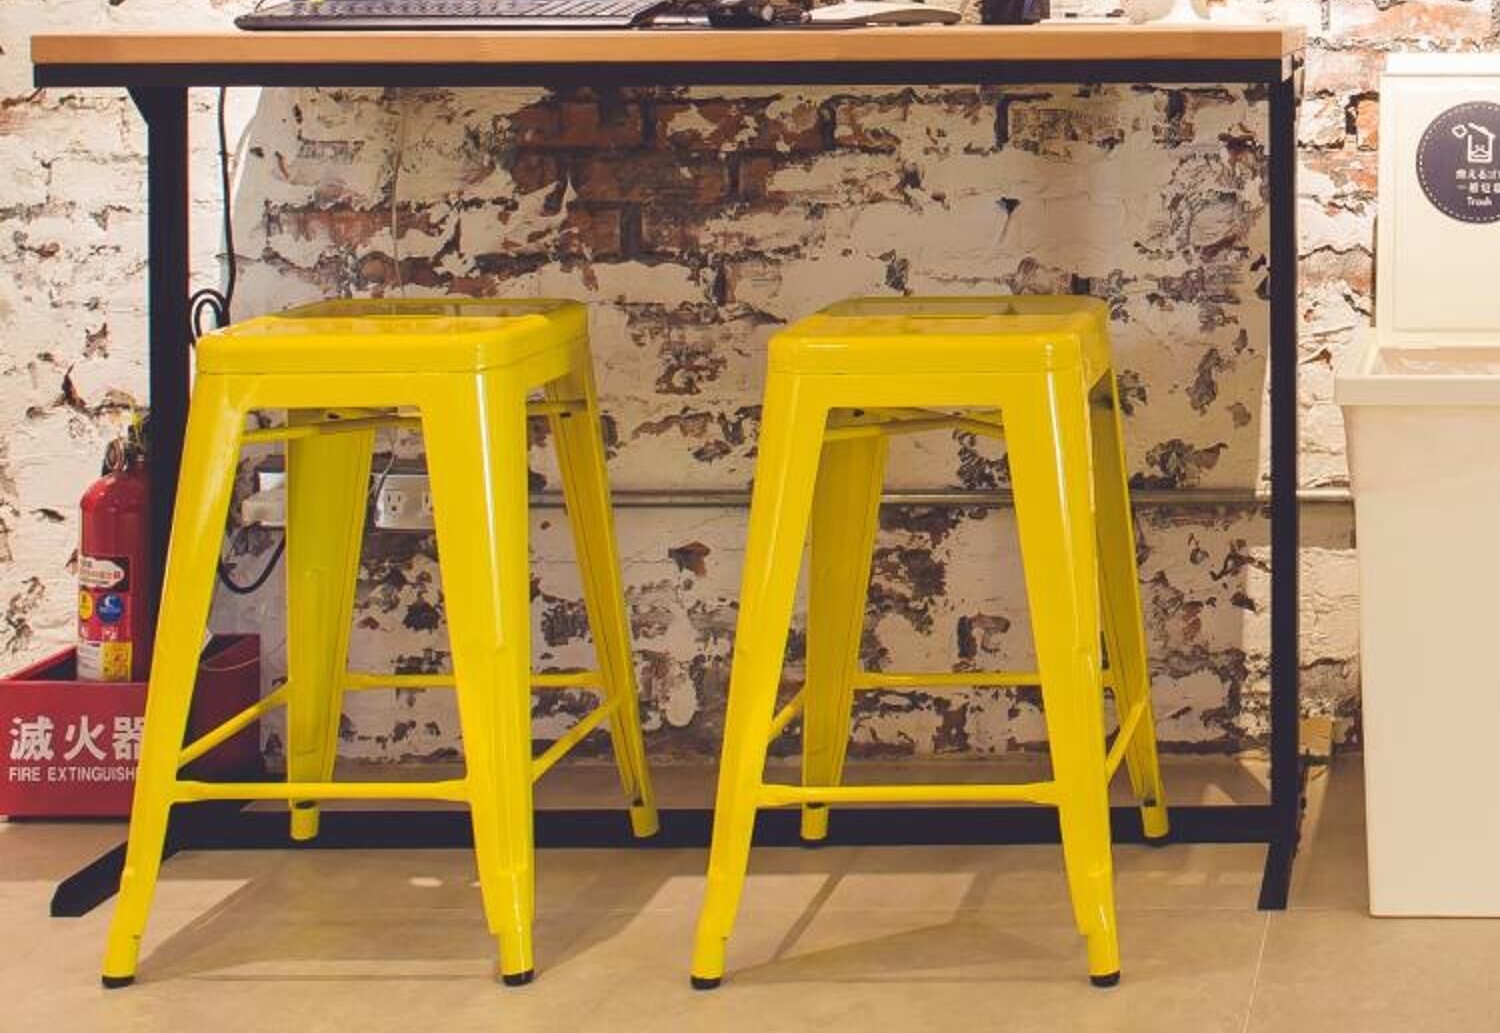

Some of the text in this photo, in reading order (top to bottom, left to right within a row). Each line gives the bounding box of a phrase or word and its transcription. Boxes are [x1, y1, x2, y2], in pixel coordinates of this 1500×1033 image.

[9, 715, 145, 761] 滅火器
[9, 766, 136, 782] FIRE EXTINGUISH
